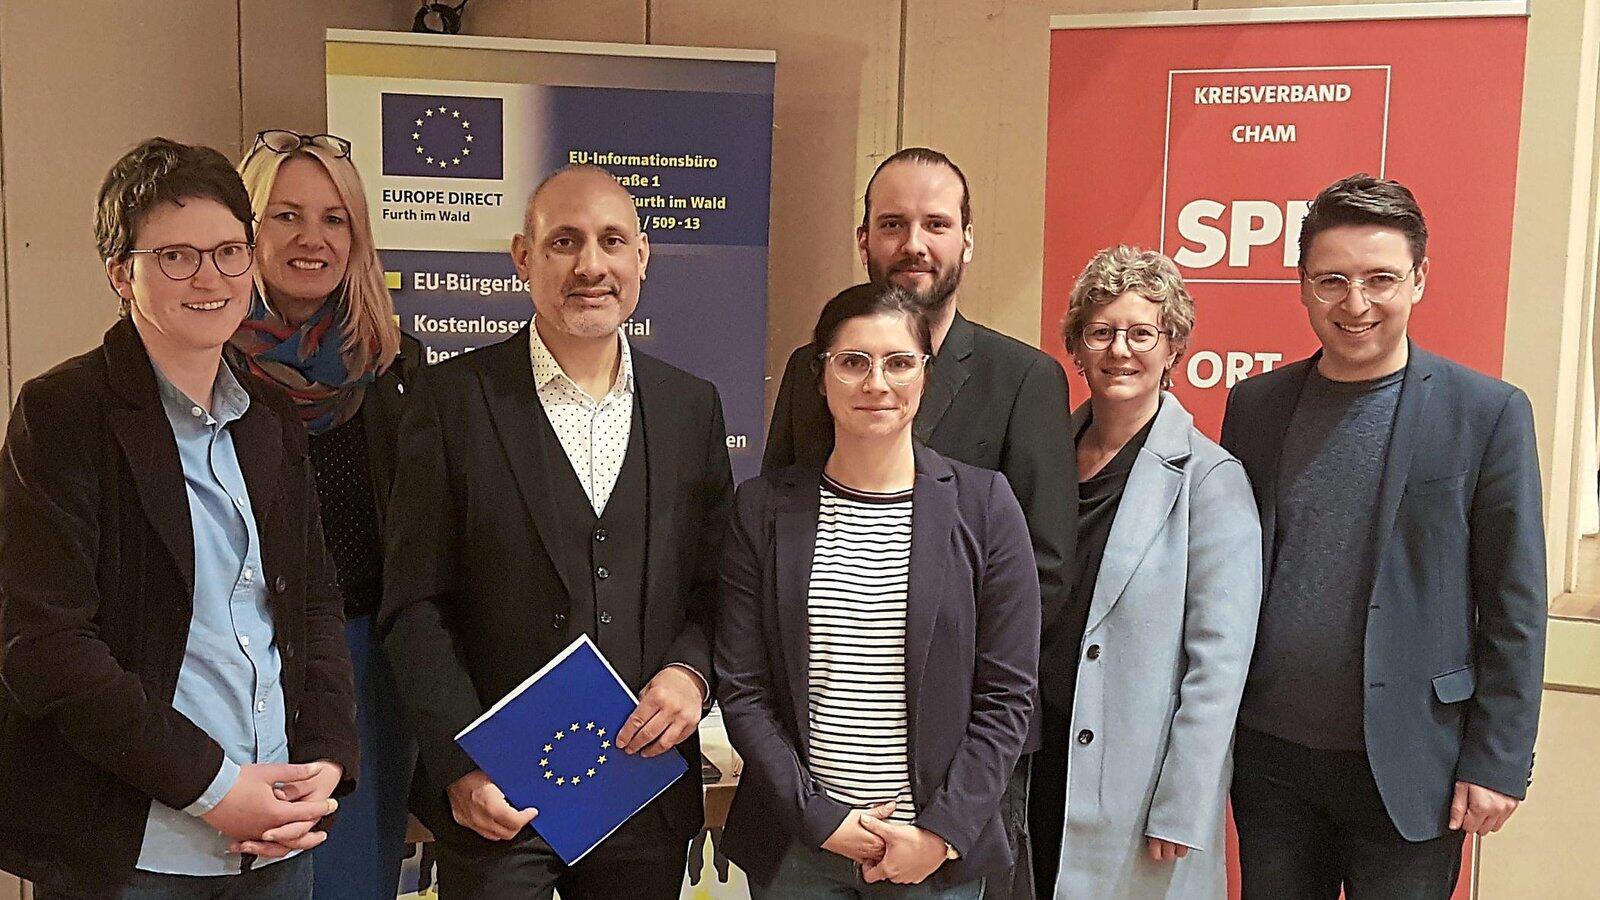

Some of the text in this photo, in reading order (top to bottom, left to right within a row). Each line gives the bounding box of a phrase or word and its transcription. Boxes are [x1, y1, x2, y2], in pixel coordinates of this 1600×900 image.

[1194, 84, 1352, 104] KREISVERBAND
[1232, 124, 1297, 143] CHAM
[568, 150, 718, 168] EU-Informationsbüro
[613, 174, 661, 187] raße 1
[382, 189, 504, 206] EUROPE DIRECT
[669, 195, 687, 209] im
[690, 196, 727, 210] Wald
[382, 208, 471, 222] Furth im Wald
[1186, 350, 1283, 389] ORT
